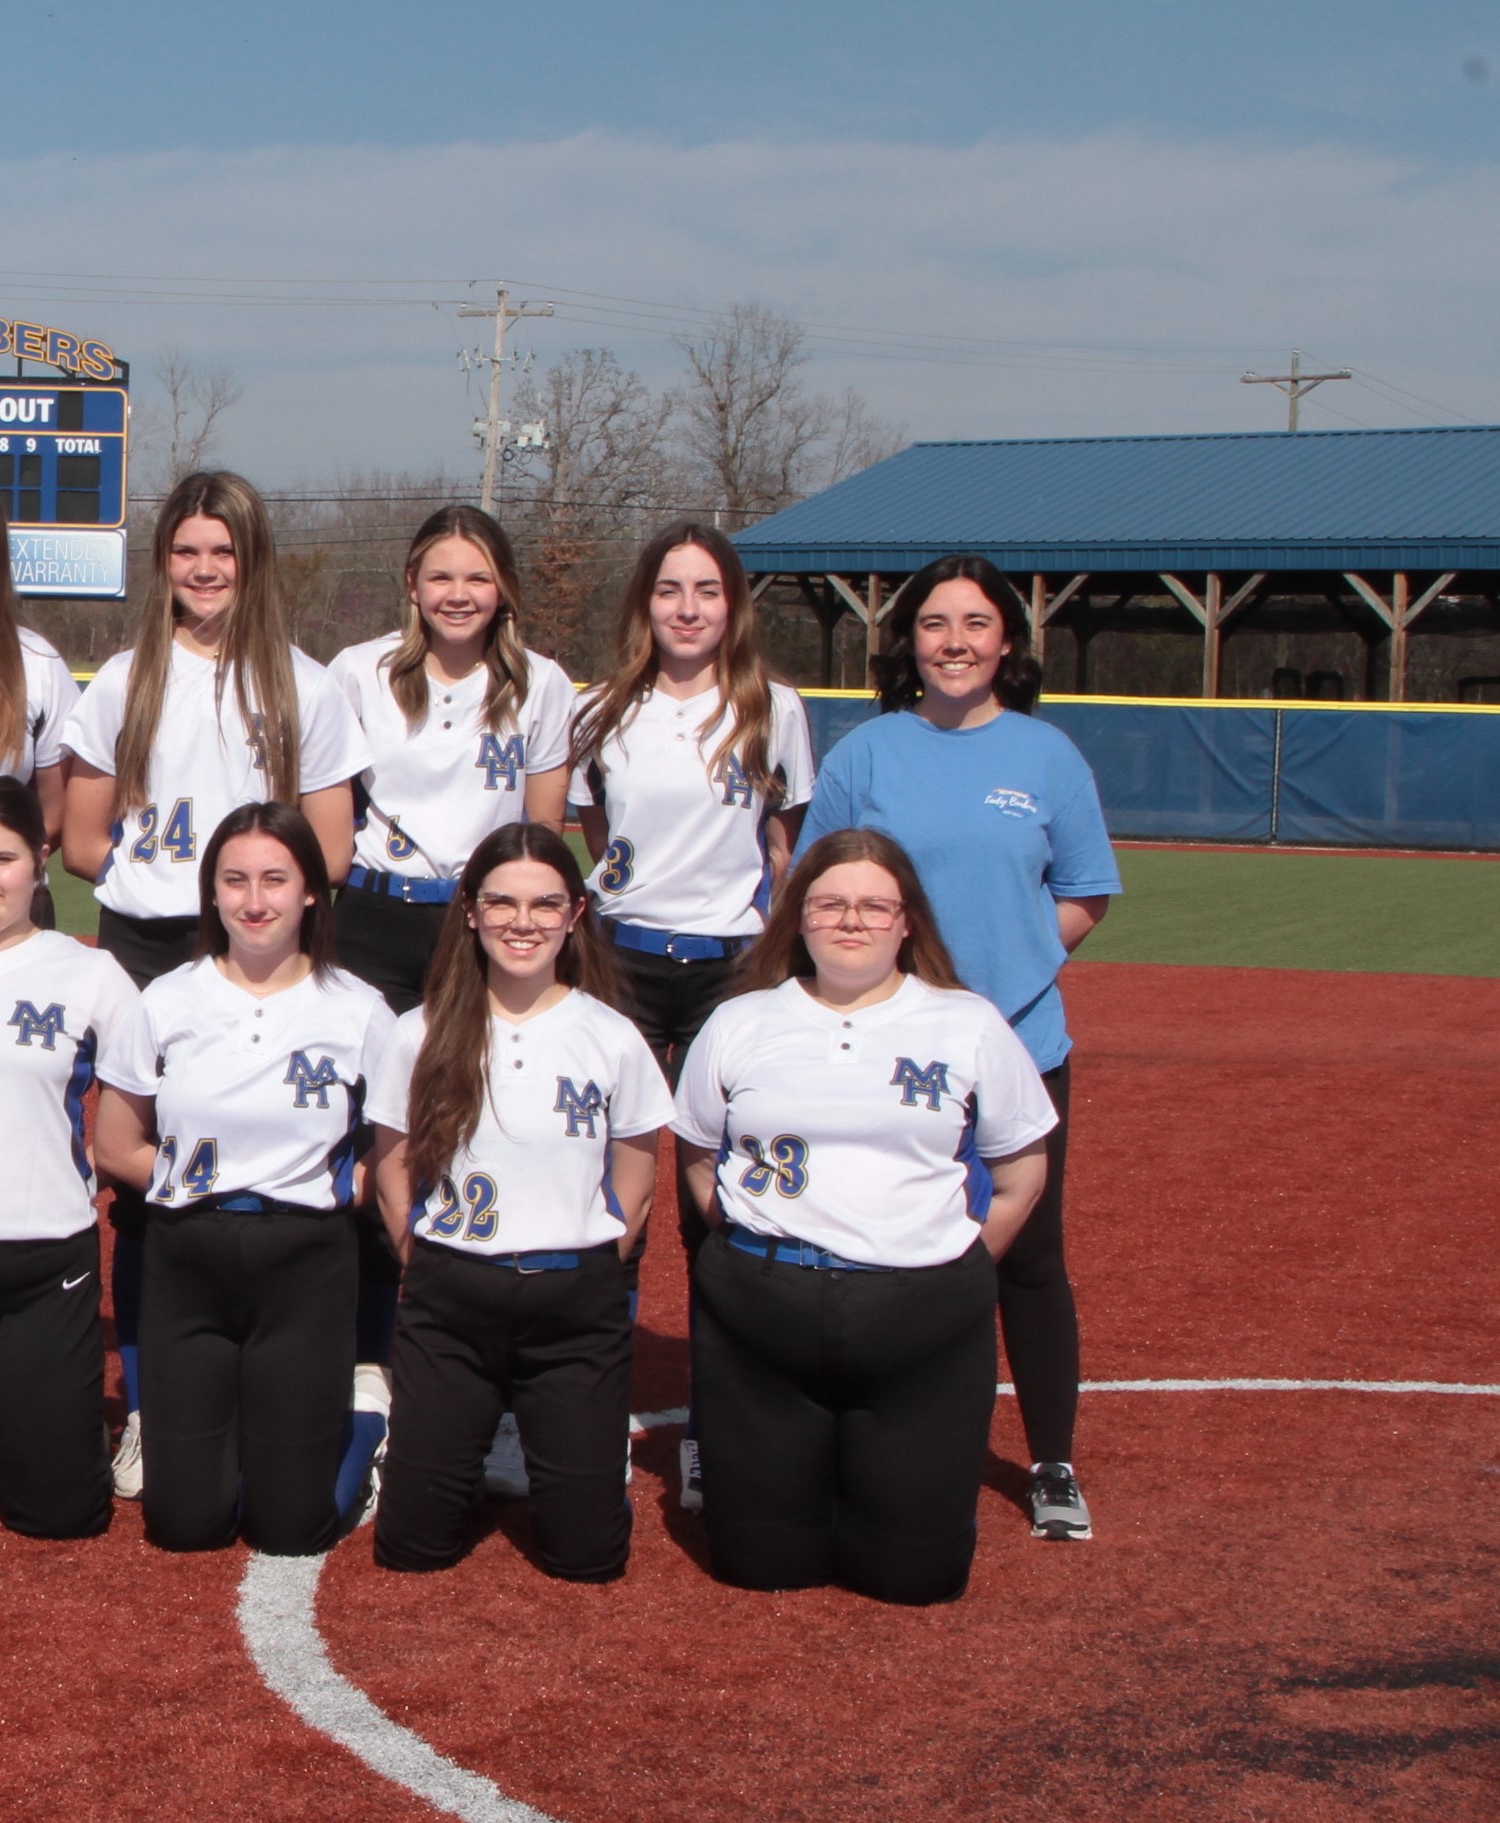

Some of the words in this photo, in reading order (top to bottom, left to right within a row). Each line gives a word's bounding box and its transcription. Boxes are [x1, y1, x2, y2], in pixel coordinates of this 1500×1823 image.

[26, 438, 37, 452] 9
[55, 438, 102, 453] TOTAL
[131, 797, 196, 863] 24
[599, 836, 634, 895] 3
[154, 1135, 220, 1202] 14
[738, 1133, 809, 1199] 23
[425, 1171, 499, 1242] 22
